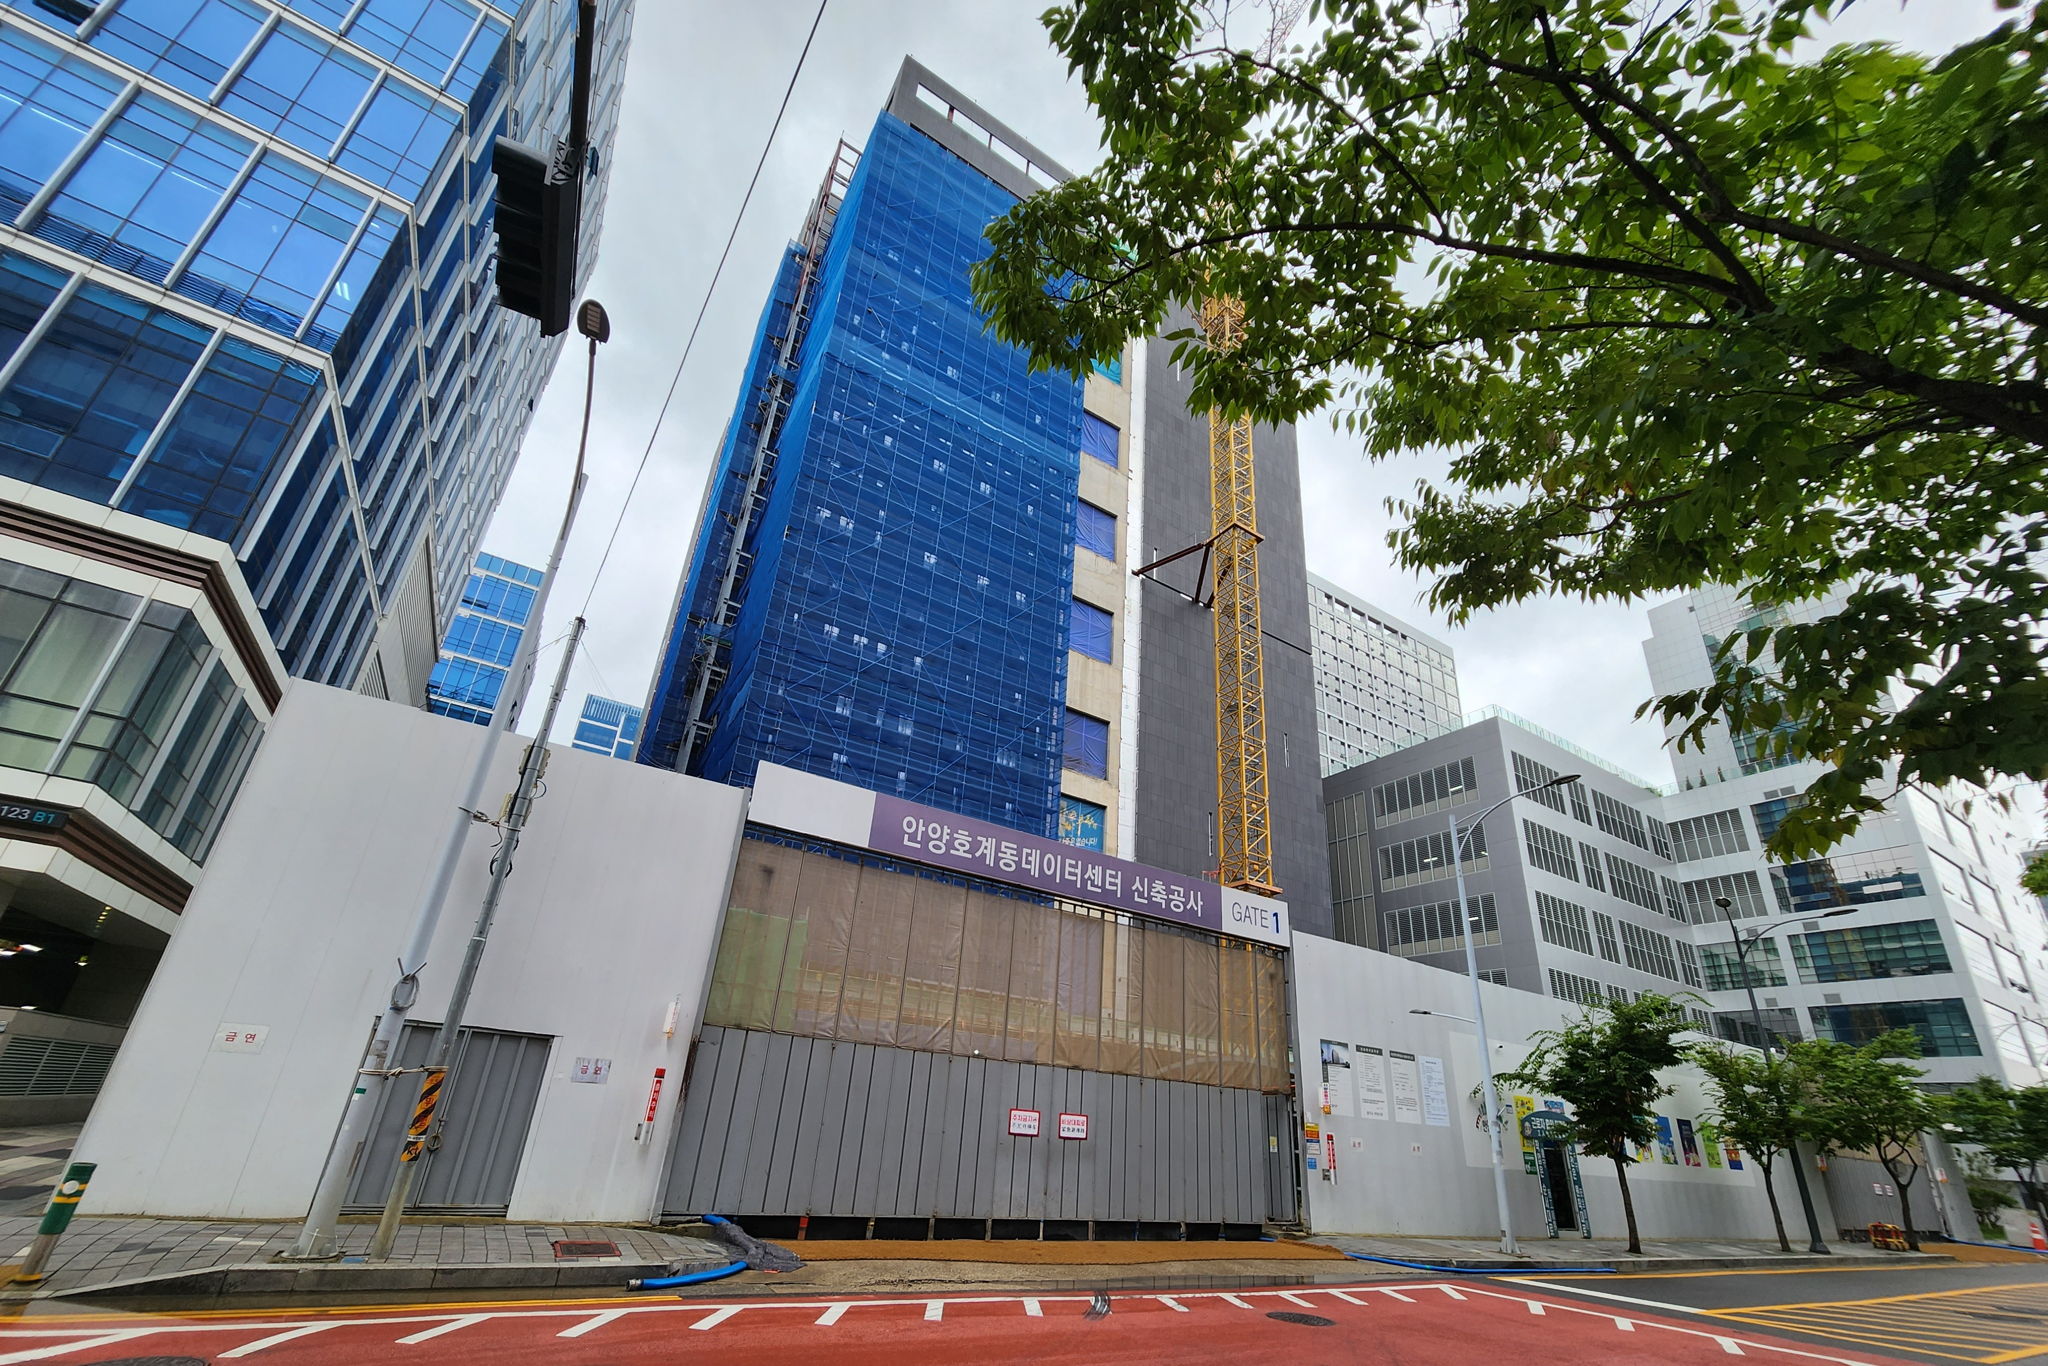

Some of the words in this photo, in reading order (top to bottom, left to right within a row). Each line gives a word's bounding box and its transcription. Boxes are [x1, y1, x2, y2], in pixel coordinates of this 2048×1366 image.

[32, 811, 55, 824] B1
[902, 816, 1122, 897] 안양호계동데이터센터
[1131, 876, 1203, 917] 신축공사
[1232, 902, 1269, 928] GATE
[1272, 912, 1280, 934] 1
